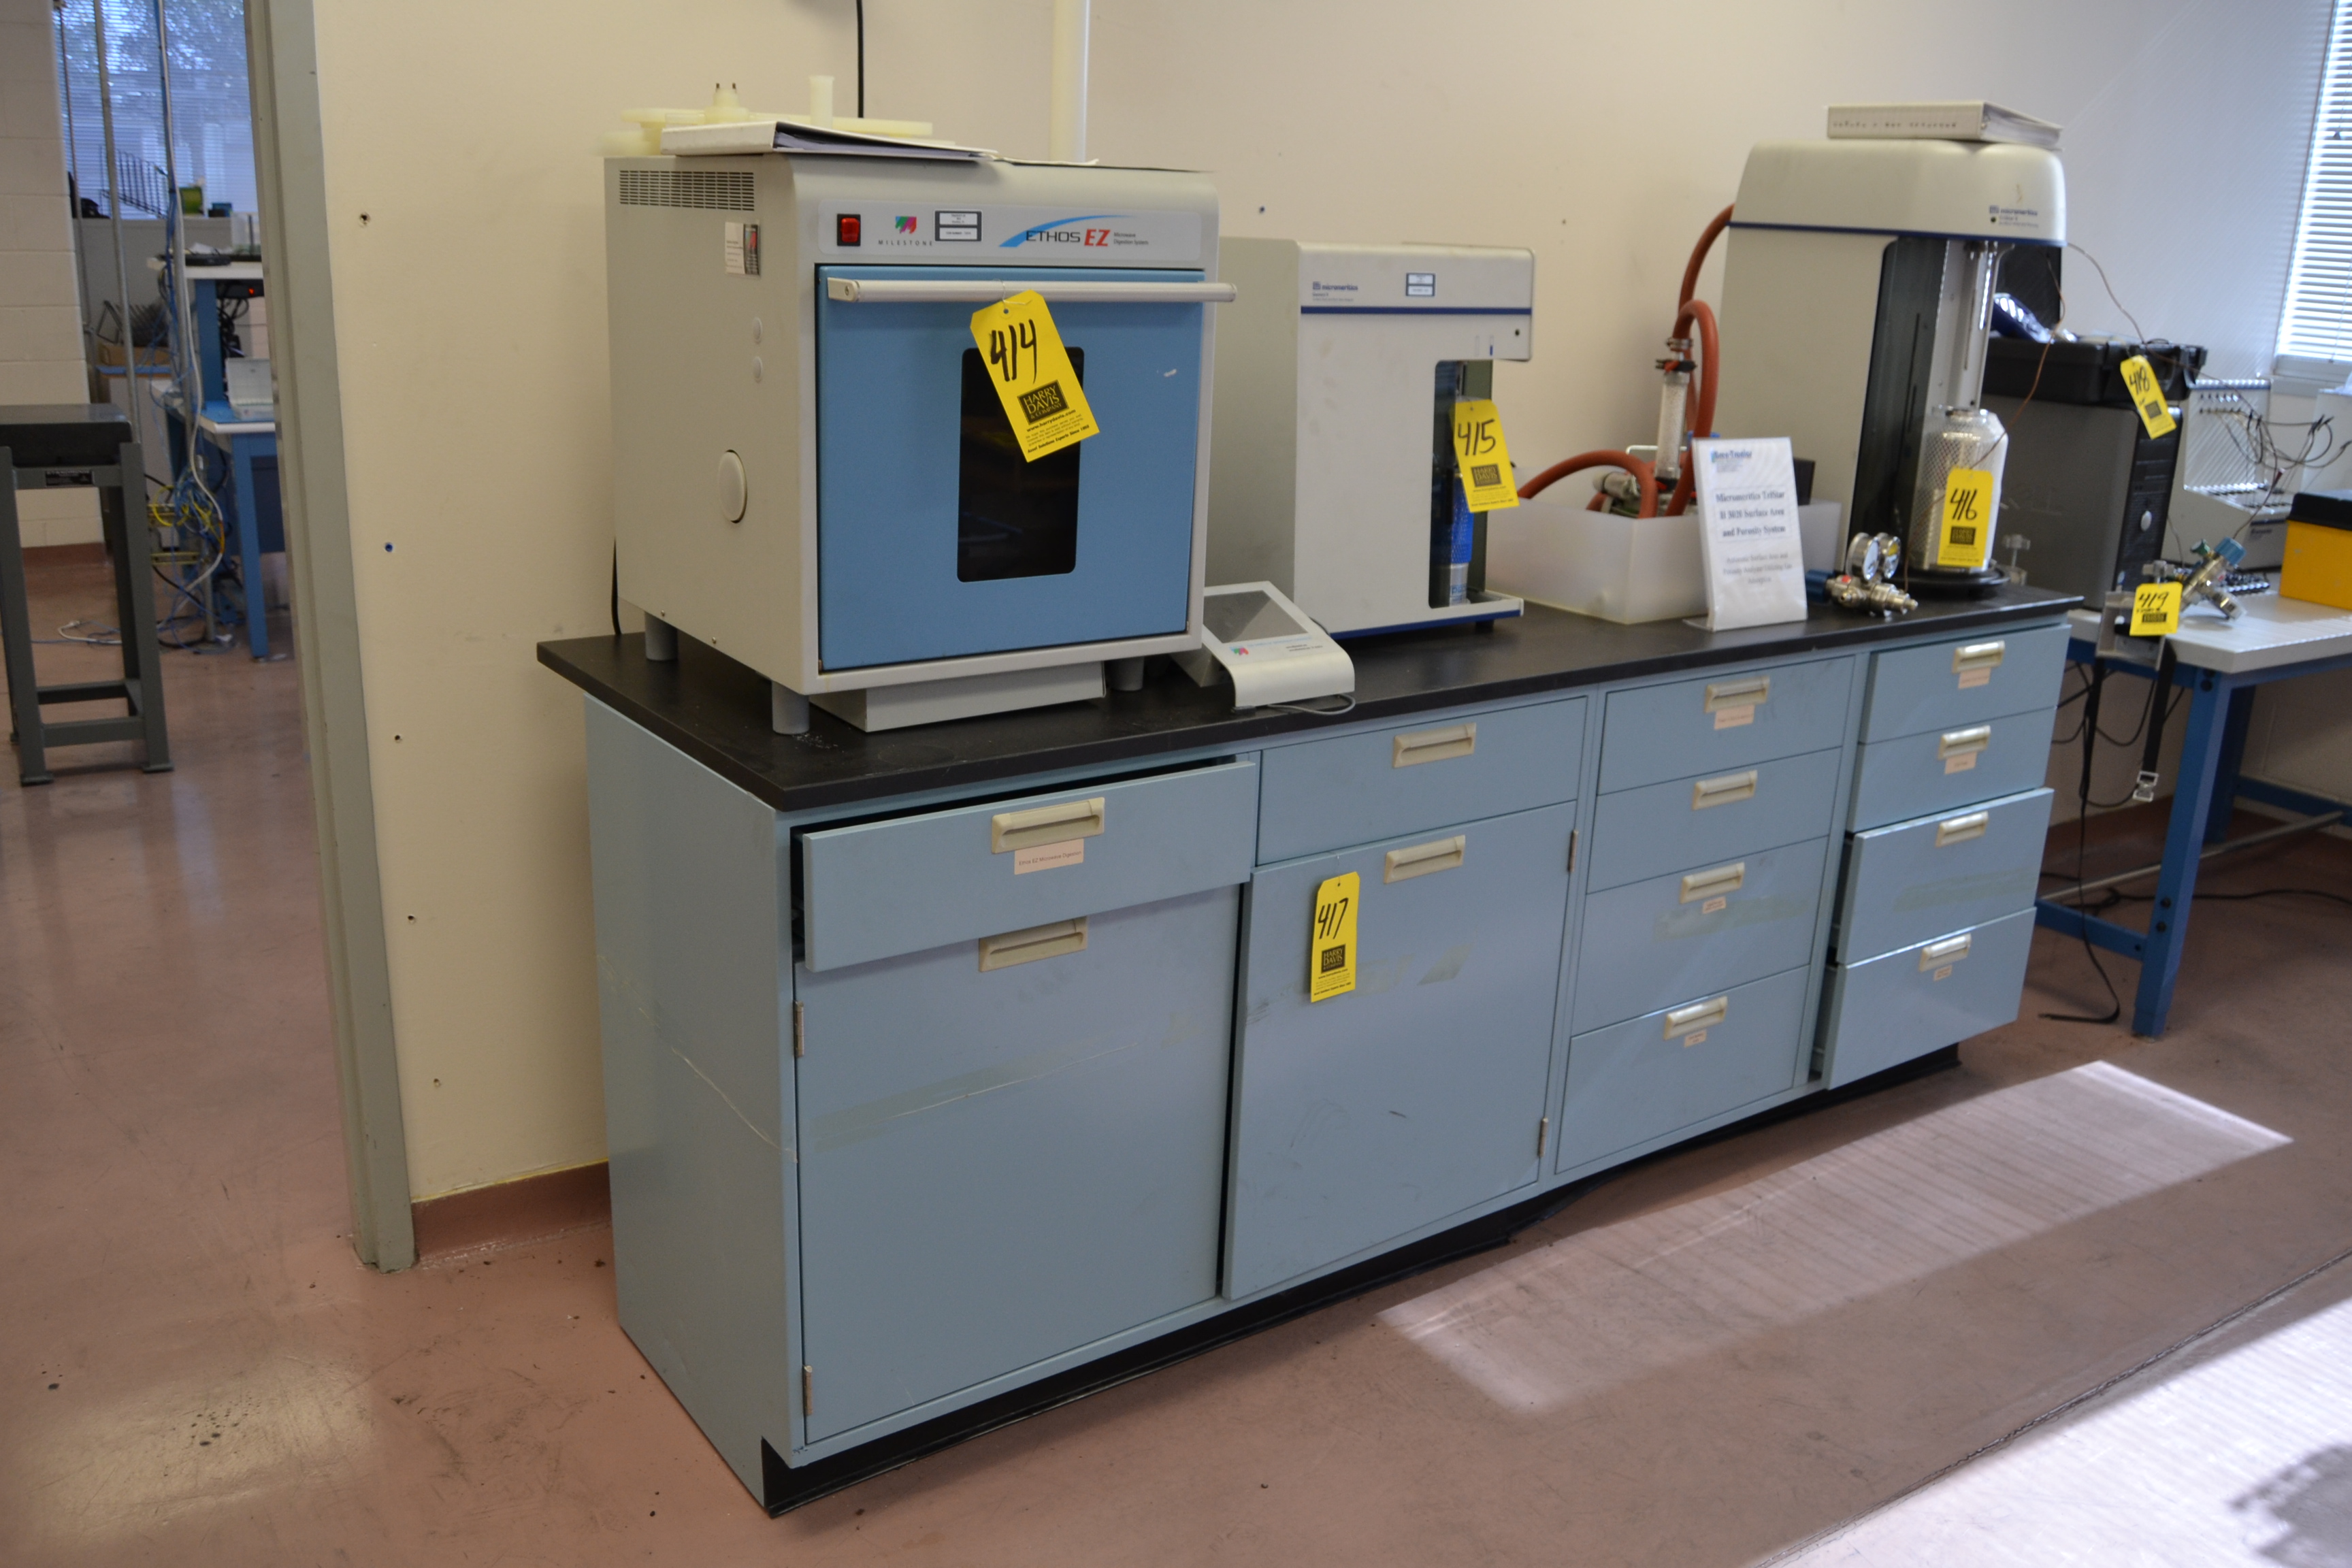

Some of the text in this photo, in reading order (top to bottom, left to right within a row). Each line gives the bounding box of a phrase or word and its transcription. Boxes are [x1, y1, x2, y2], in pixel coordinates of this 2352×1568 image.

[1026, 228, 1111, 246] ETHOS EZ
[989, 318, 1037, 385] 414
[2129, 365, 2151, 395] 418
[1023, 385, 1057, 405] HARRY
[1026, 394, 1060, 414] DAVIS
[1035, 402, 1062, 416] COMPANY
[1458, 419, 1496, 456] 415
[1950, 488, 1978, 521] 416
[1722, 527, 1735, 537] and
[2138, 591, 2169, 611] 419
[1318, 897, 1349, 940] 417
[1323, 955, 1343, 966] DAVIS
[1324, 948, 1343, 958] HARRY
